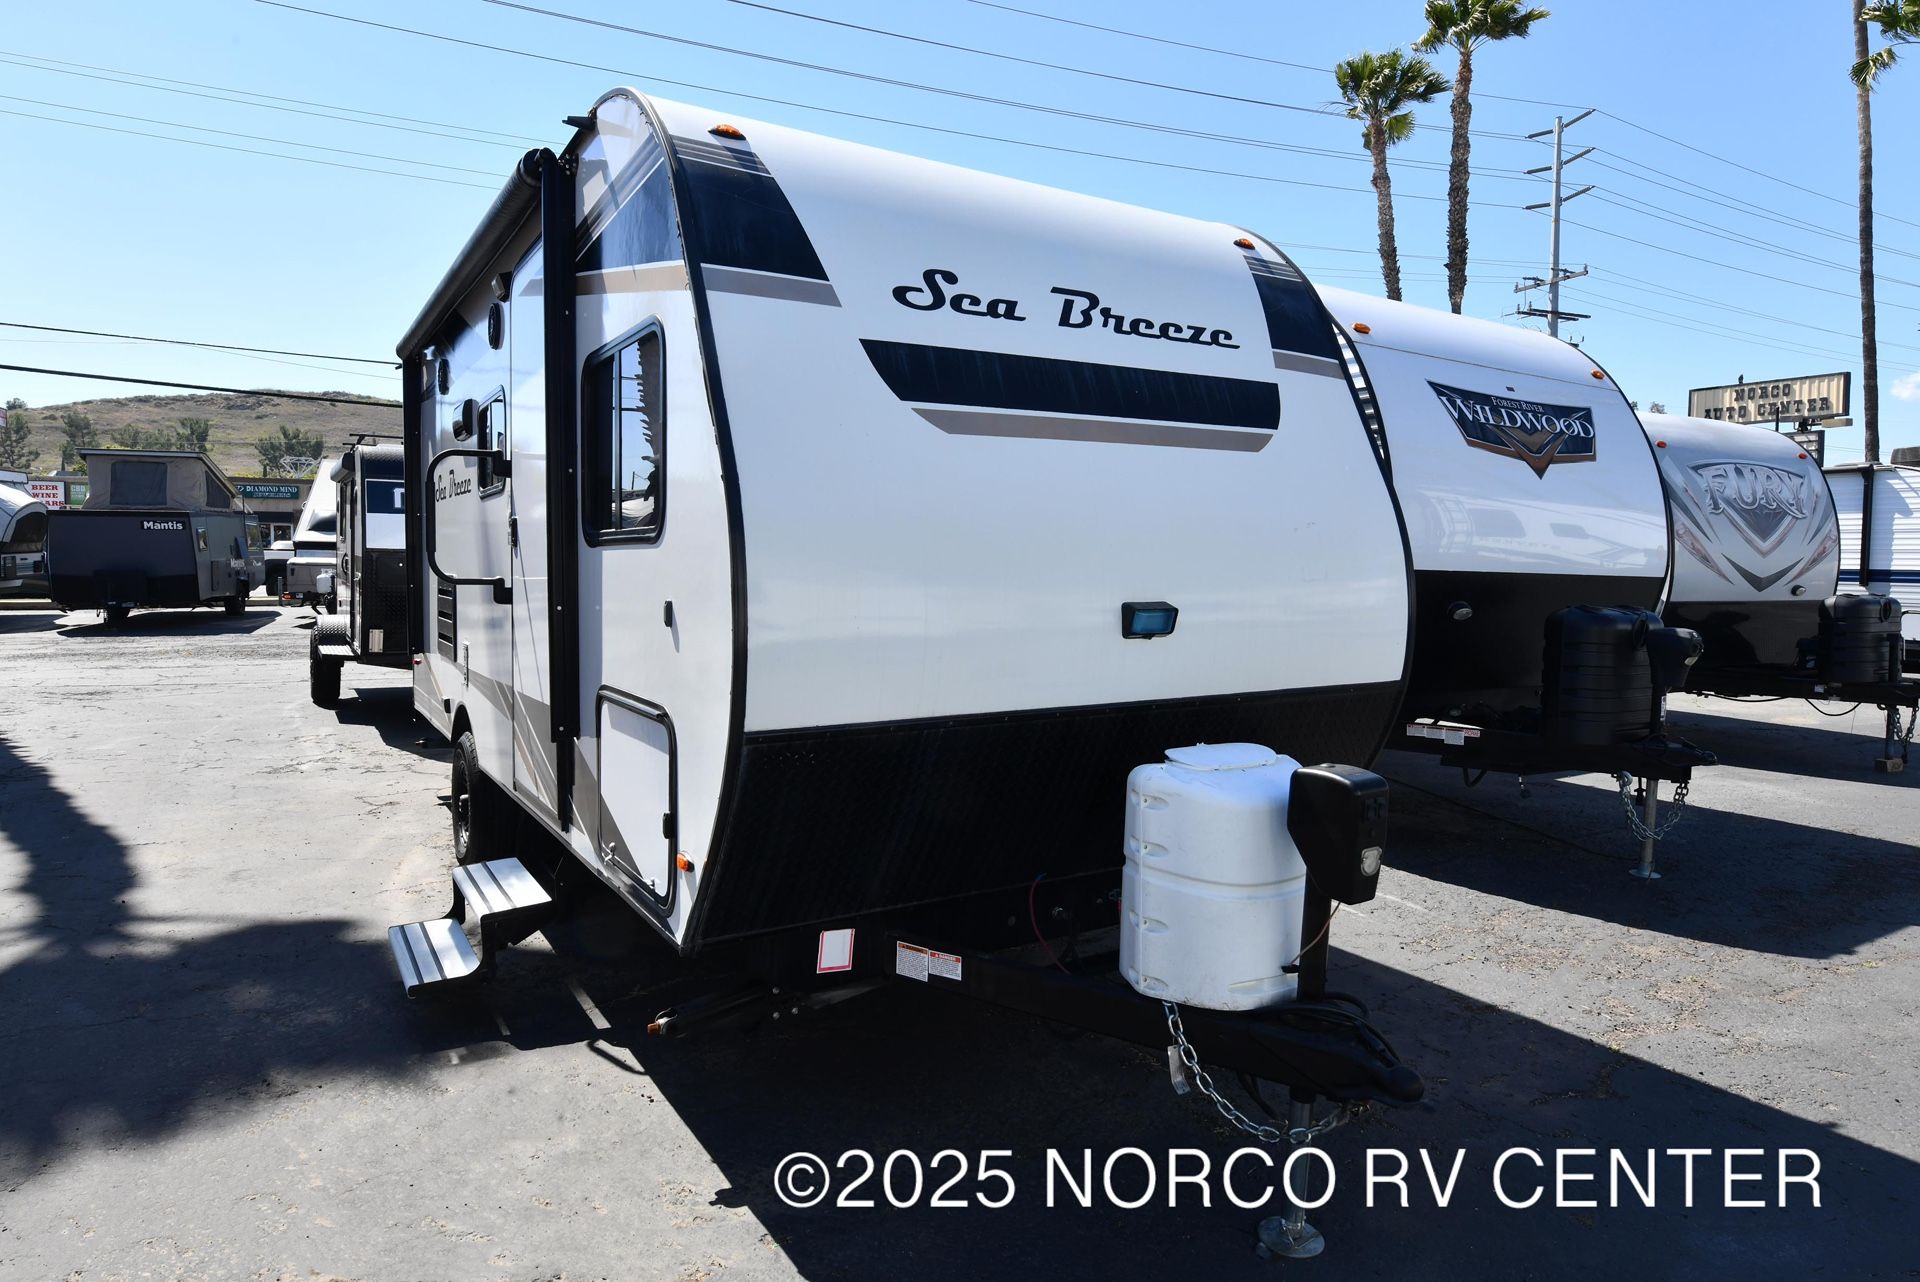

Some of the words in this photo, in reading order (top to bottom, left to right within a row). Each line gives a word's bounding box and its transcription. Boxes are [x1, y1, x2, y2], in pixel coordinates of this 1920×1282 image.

[892, 268, 1027, 322] Sea
[1050, 286, 1241, 350] Breeze
[1734, 383, 1791, 402] NORCO
[1491, 397, 1520, 409] FOREST
[1521, 401, 1544, 412] RIVER
[1704, 405, 1747, 420] AUTO
[1757, 397, 1830, 416] CENTER
[1438, 395, 1594, 438] WILDWOOD
[1697, 463, 1807, 519] FURY
[143, 521, 183, 530] Mantis
